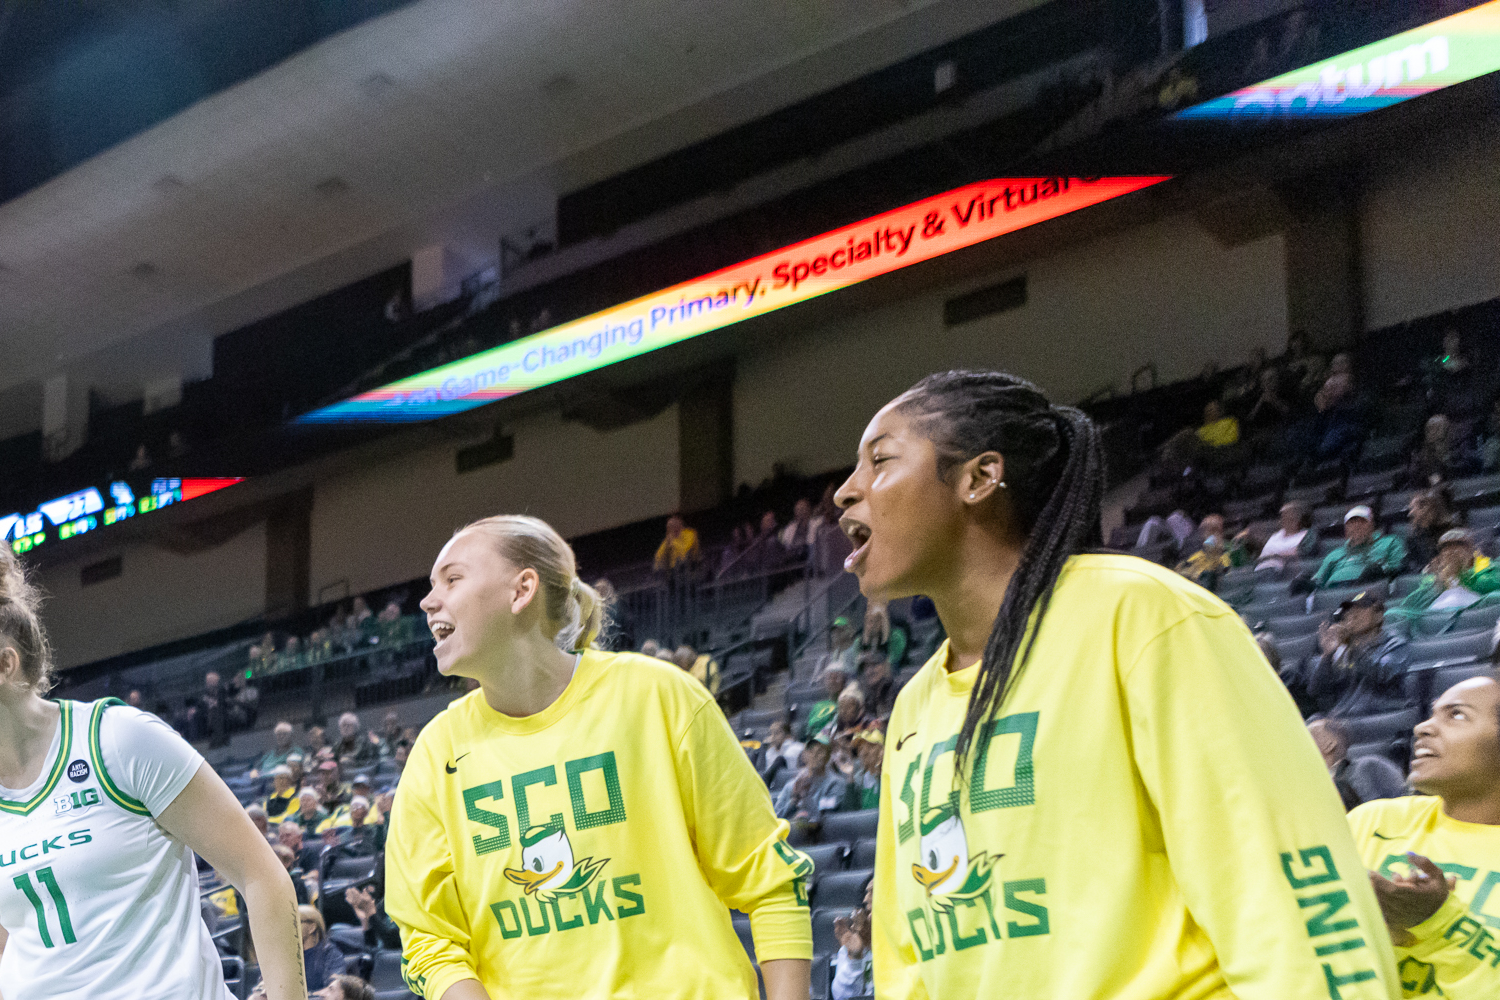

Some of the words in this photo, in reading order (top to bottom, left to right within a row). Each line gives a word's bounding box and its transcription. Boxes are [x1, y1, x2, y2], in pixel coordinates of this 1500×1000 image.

[440, 316, 644, 402] Game-Changing
[649, 274, 766, 332] Primary,
[772, 221, 916, 291] Specialty
[921, 211, 945, 239] &
[462, 751, 627, 856] SCO
[12, 865, 78, 949] 11
[490, 873, 646, 941] DUCKS
